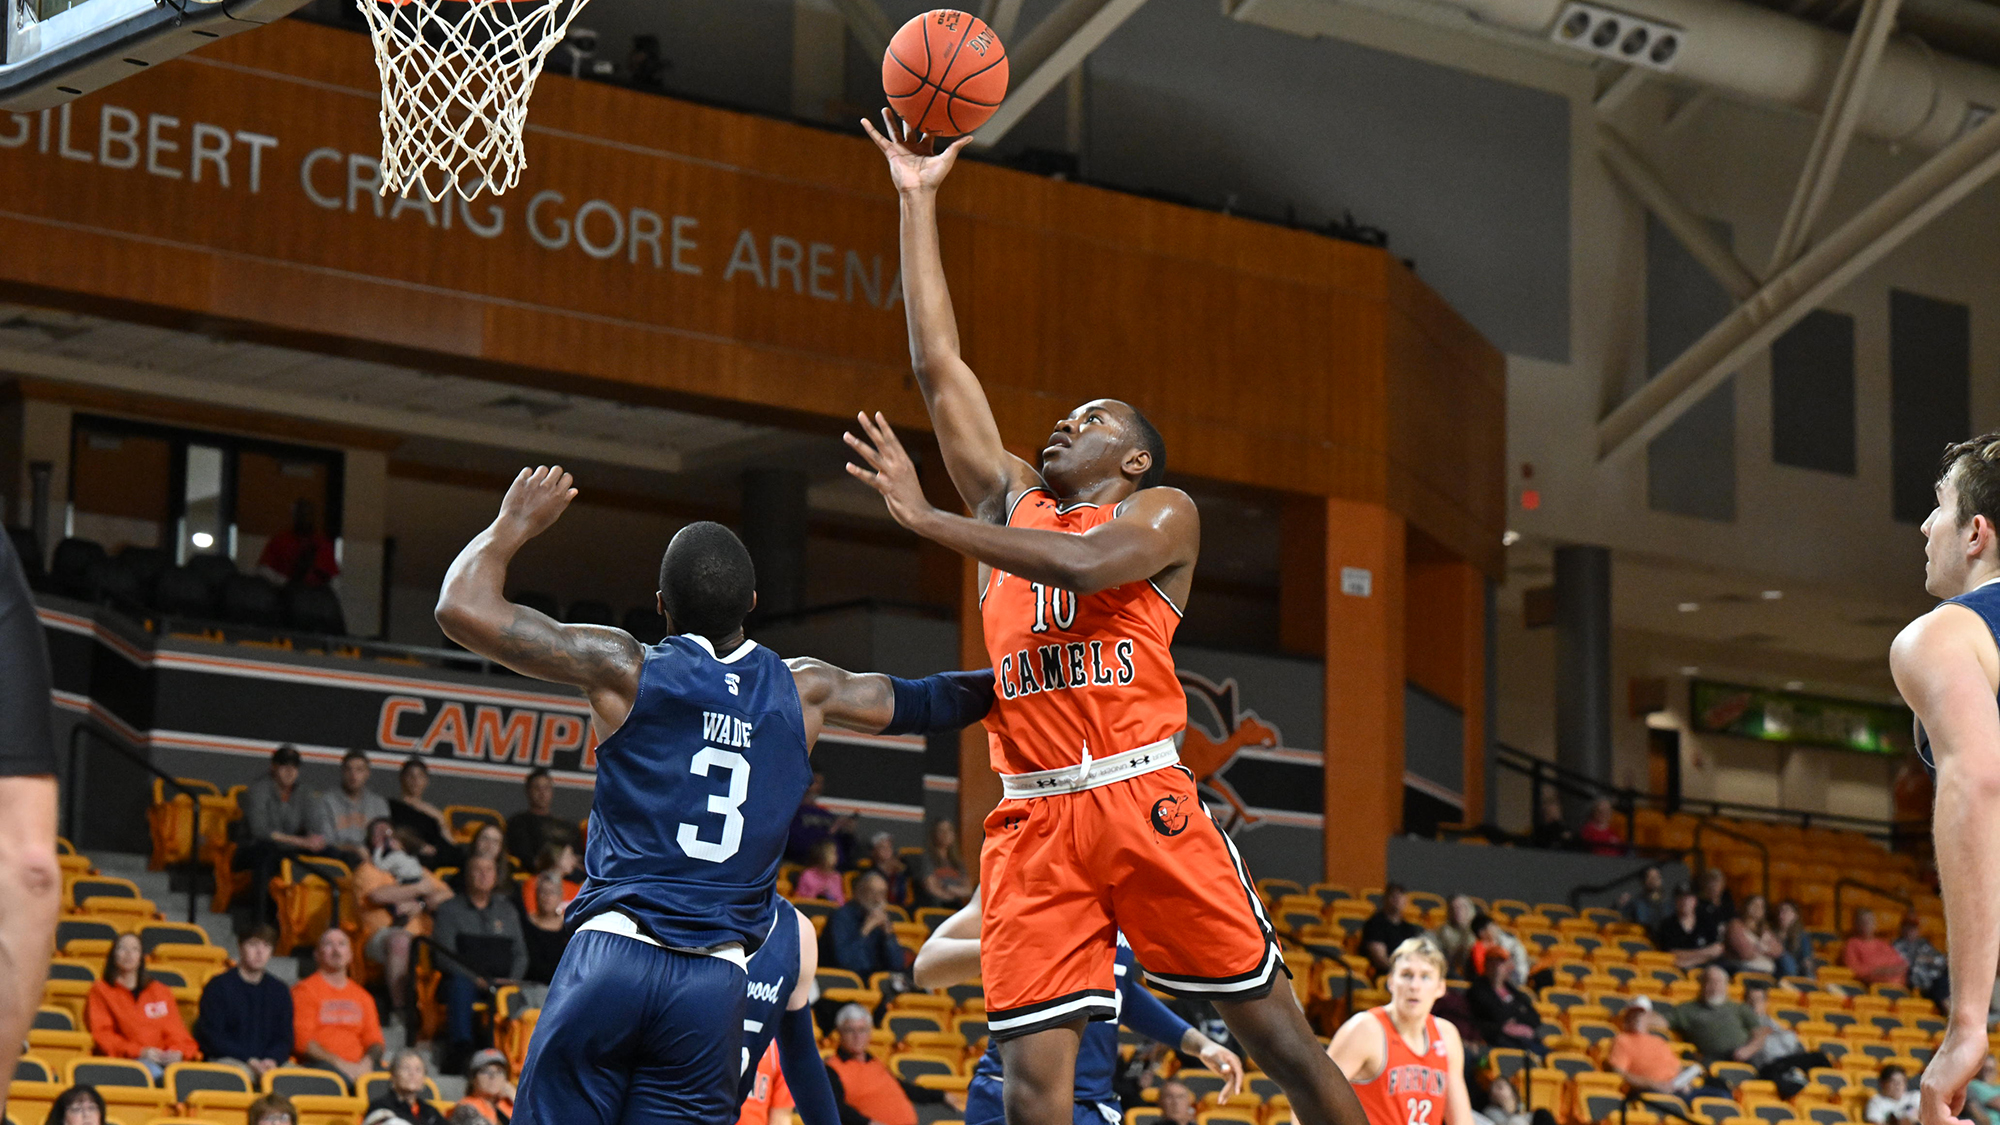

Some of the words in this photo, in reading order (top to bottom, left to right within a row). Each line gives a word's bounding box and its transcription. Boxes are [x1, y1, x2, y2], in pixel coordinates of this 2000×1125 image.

[301, 147, 506, 238] CRAIG
[525, 189, 700, 275] GORE
[1030, 581, 1077, 633] 10
[1001, 638, 1135, 700] CAMELS
[702, 711, 753, 748] WADE
[676, 746, 751, 864] 3
[1406, 1097, 1433, 1125] 22
